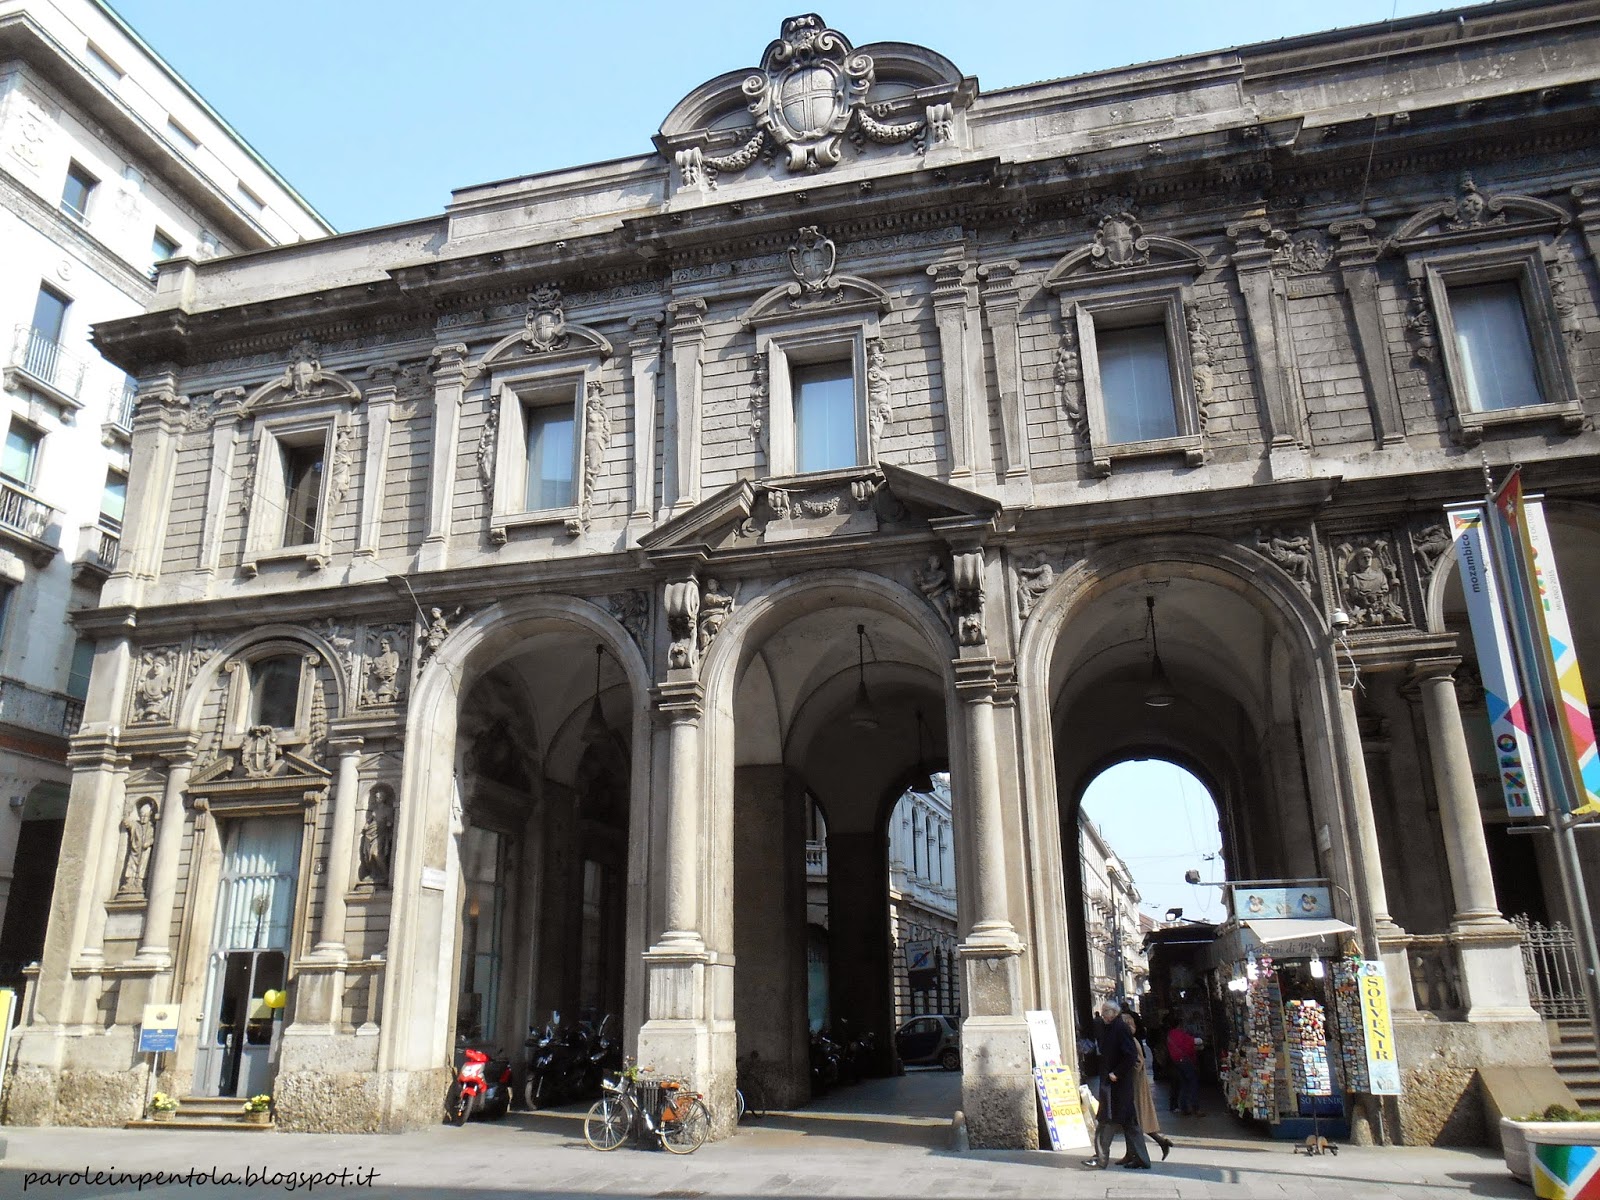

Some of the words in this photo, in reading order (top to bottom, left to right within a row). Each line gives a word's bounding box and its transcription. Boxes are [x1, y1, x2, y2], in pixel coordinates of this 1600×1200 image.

[1462, 534, 1480, 592] mozambico
[1552, 585, 1563, 611] MILANO
[1497, 733, 1530, 807] EXPO
[1367, 978, 1388, 1060] SOUVENIR
[1300, 1096, 1344, 1106] SOVENIR
